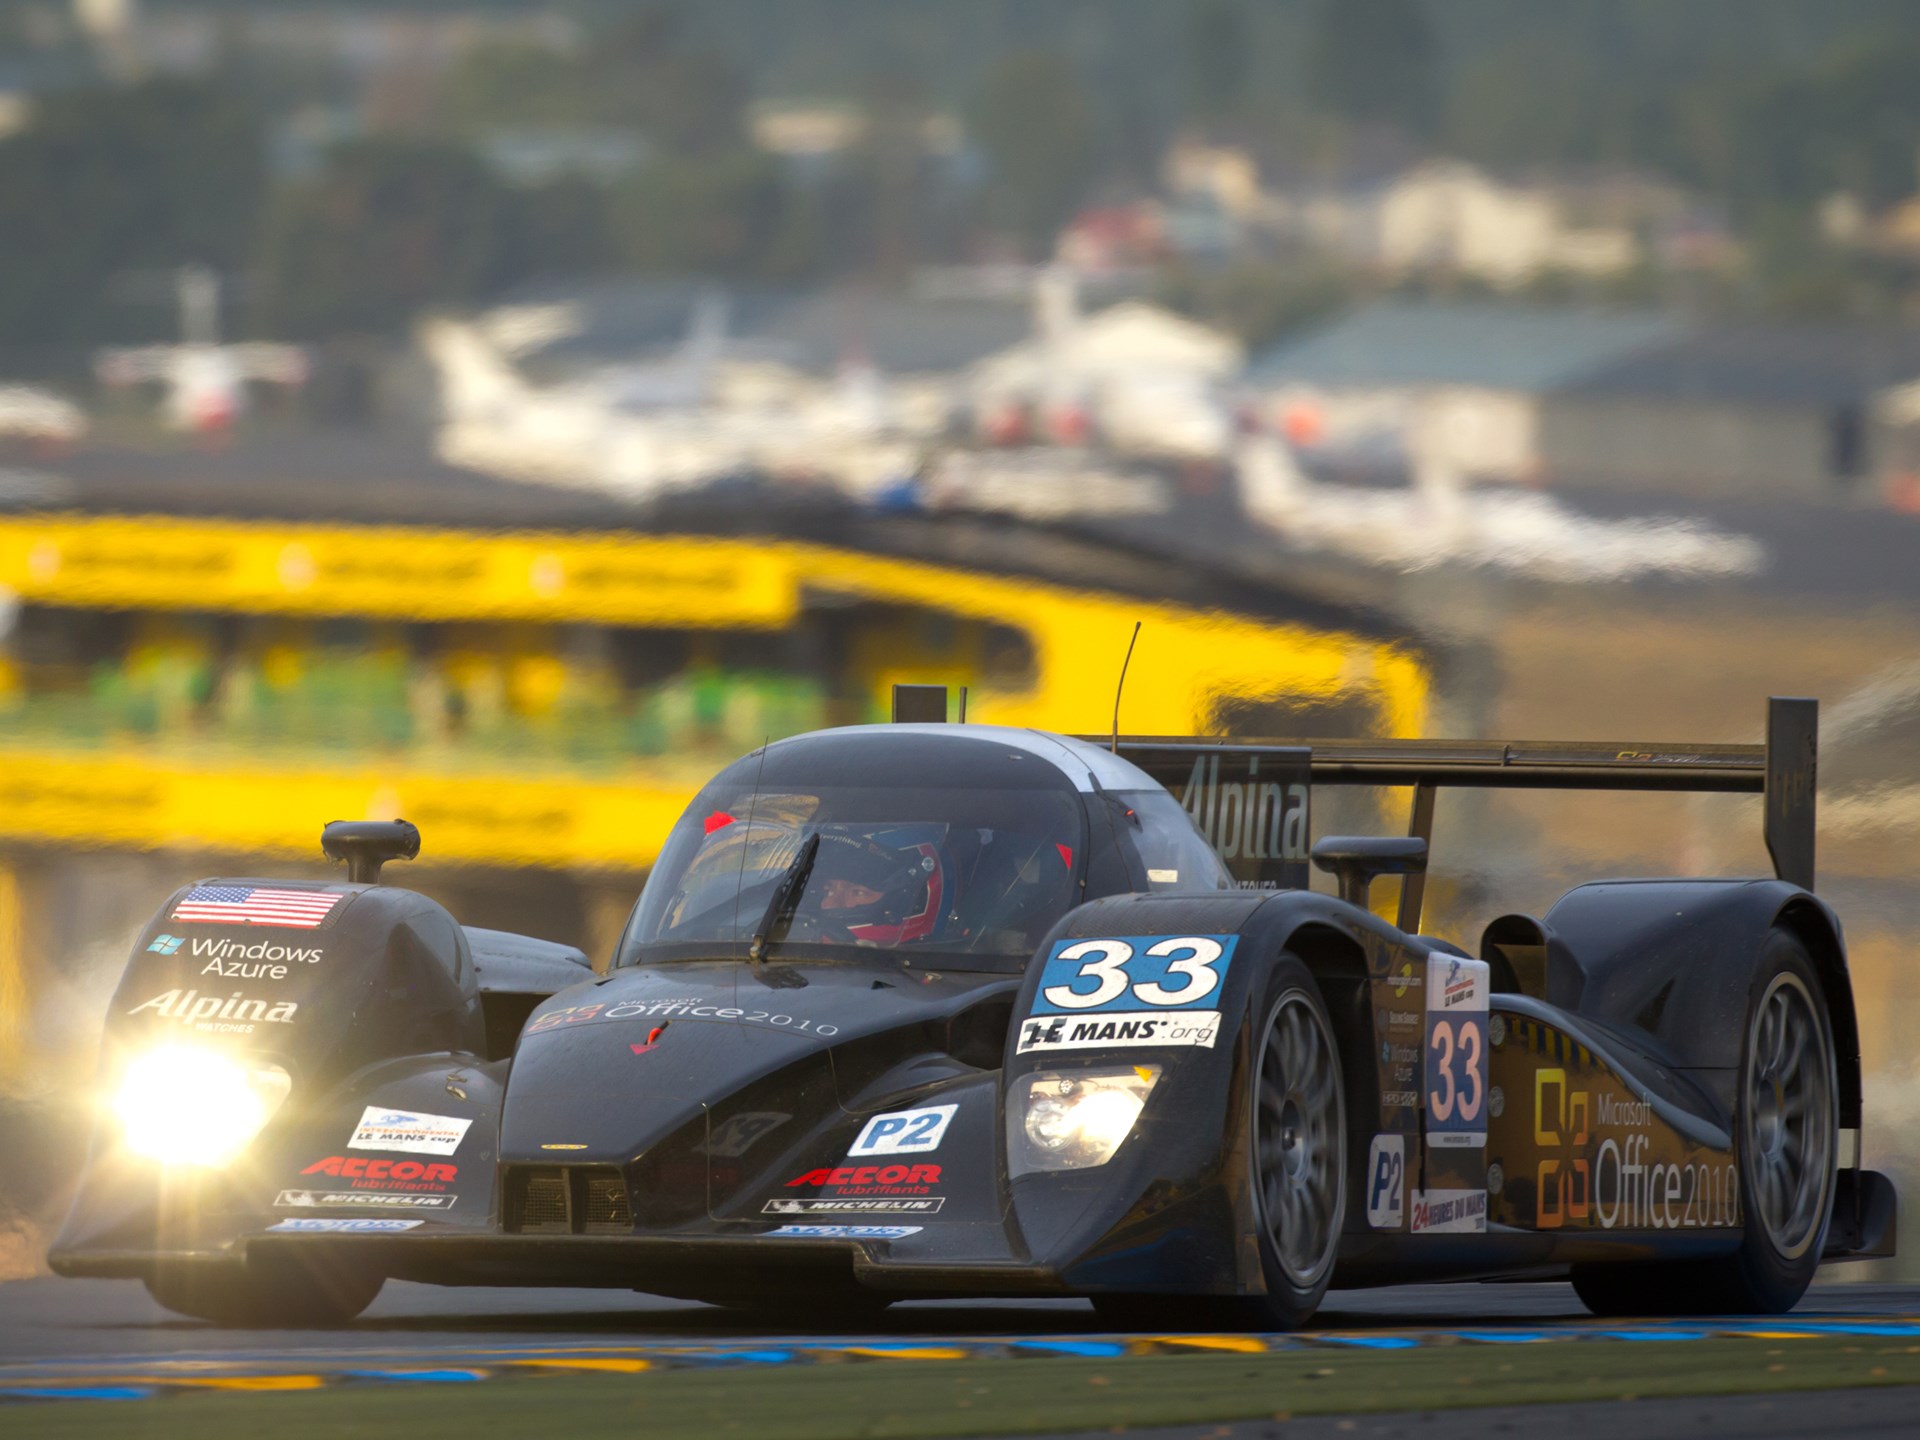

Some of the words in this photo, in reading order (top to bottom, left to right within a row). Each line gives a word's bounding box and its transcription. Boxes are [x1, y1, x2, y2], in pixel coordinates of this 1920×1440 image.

[191, 938, 324, 964] Windows
[201, 957, 288, 979] Azure
[1043, 936, 1223, 1009] 33
[127, 988, 299, 1024] Alpina
[605, 1002, 744, 1018] Office
[745, 1011, 839, 1036] 2010
[194, 1022, 255, 1034] WATCHES
[1431, 1021, 1482, 1121] 33
[1597, 1092, 1651, 1126] Microsoft
[379, 1133, 426, 1142] MANS
[861, 1113, 943, 1150] P2
[300, 1156, 458, 1182] ACCOR
[784, 1164, 942, 1187] ACCOR
[1370, 1151, 1400, 1210] P2
[1595, 1134, 1681, 1228] Office
[1683, 1164, 1738, 1227] 2010
[322, 1194, 443, 1206] MICHELIN
[836, 1185, 931, 1196] lubrifiants
[809, 1201, 932, 1210] MICHELIN
[1412, 1201, 1429, 1231] 24
